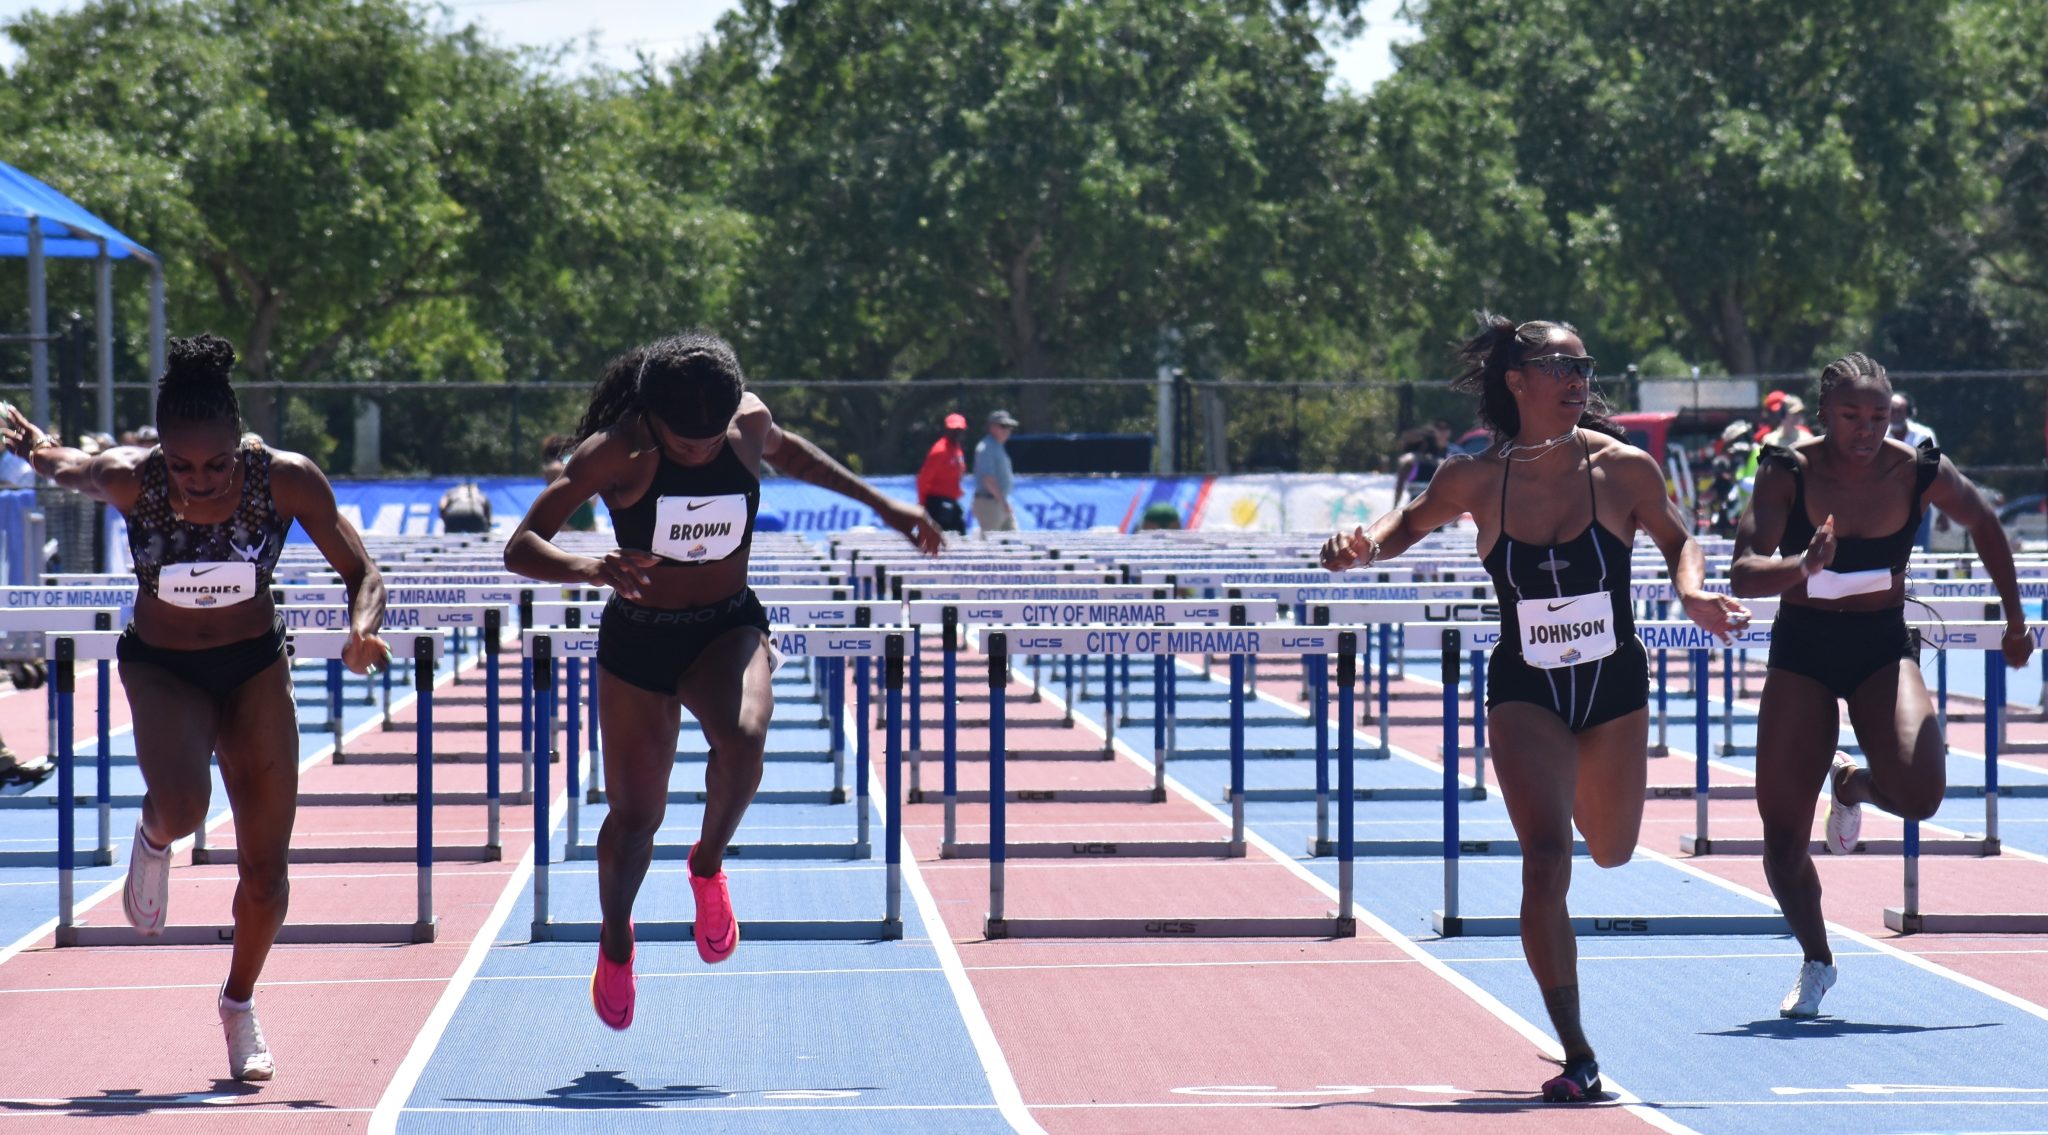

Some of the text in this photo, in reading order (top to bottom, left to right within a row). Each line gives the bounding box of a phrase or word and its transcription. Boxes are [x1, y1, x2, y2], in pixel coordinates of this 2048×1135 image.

[669, 522, 731, 541] BROWN
[1224, 573, 1250, 584] CITY
[1254, 573, 1271, 584] OF
[1273, 573, 1330, 583] MIRAMAR
[295, 593, 326, 601] UCS
[400, 590, 466, 604] MIRAMAR
[482, 592, 512, 601] UCS
[977, 589, 1007, 600] CITY
[1013, 589, 1031, 600] OF
[1034, 588, 1099, 600] MIRAMAR
[1297, 588, 1327, 600] CITY
[1331, 588, 1349, 600] OF
[1354, 587, 1419, 600] MIRAMAR
[1647, 585, 1665, 599] OF
[1933, 584, 1964, 598] CITY
[1969, 584, 1986, 598] OF
[9, 591, 134, 606] CITY OF MIRAMAR
[315, 610, 336, 627] OF
[438, 613, 473, 622] UCS
[653, 608, 715, 625] PRO
[808, 610, 844, 619] UCS
[968, 605, 1219, 622] UCS CITY OF MIRAMAR UCS
[1529, 618, 1605, 645] JOHNSON
[1934, 632, 1977, 643] UCS
[828, 639, 872, 650] UCS
[1019, 631, 1325, 653] UCS CITY OF MIRAMAR UCS
[1654, 787, 1692, 798] UCS
[1073, 843, 1117, 855] UCS
[1144, 922, 1198, 934] UCS
[1594, 919, 1648, 932] UCS
